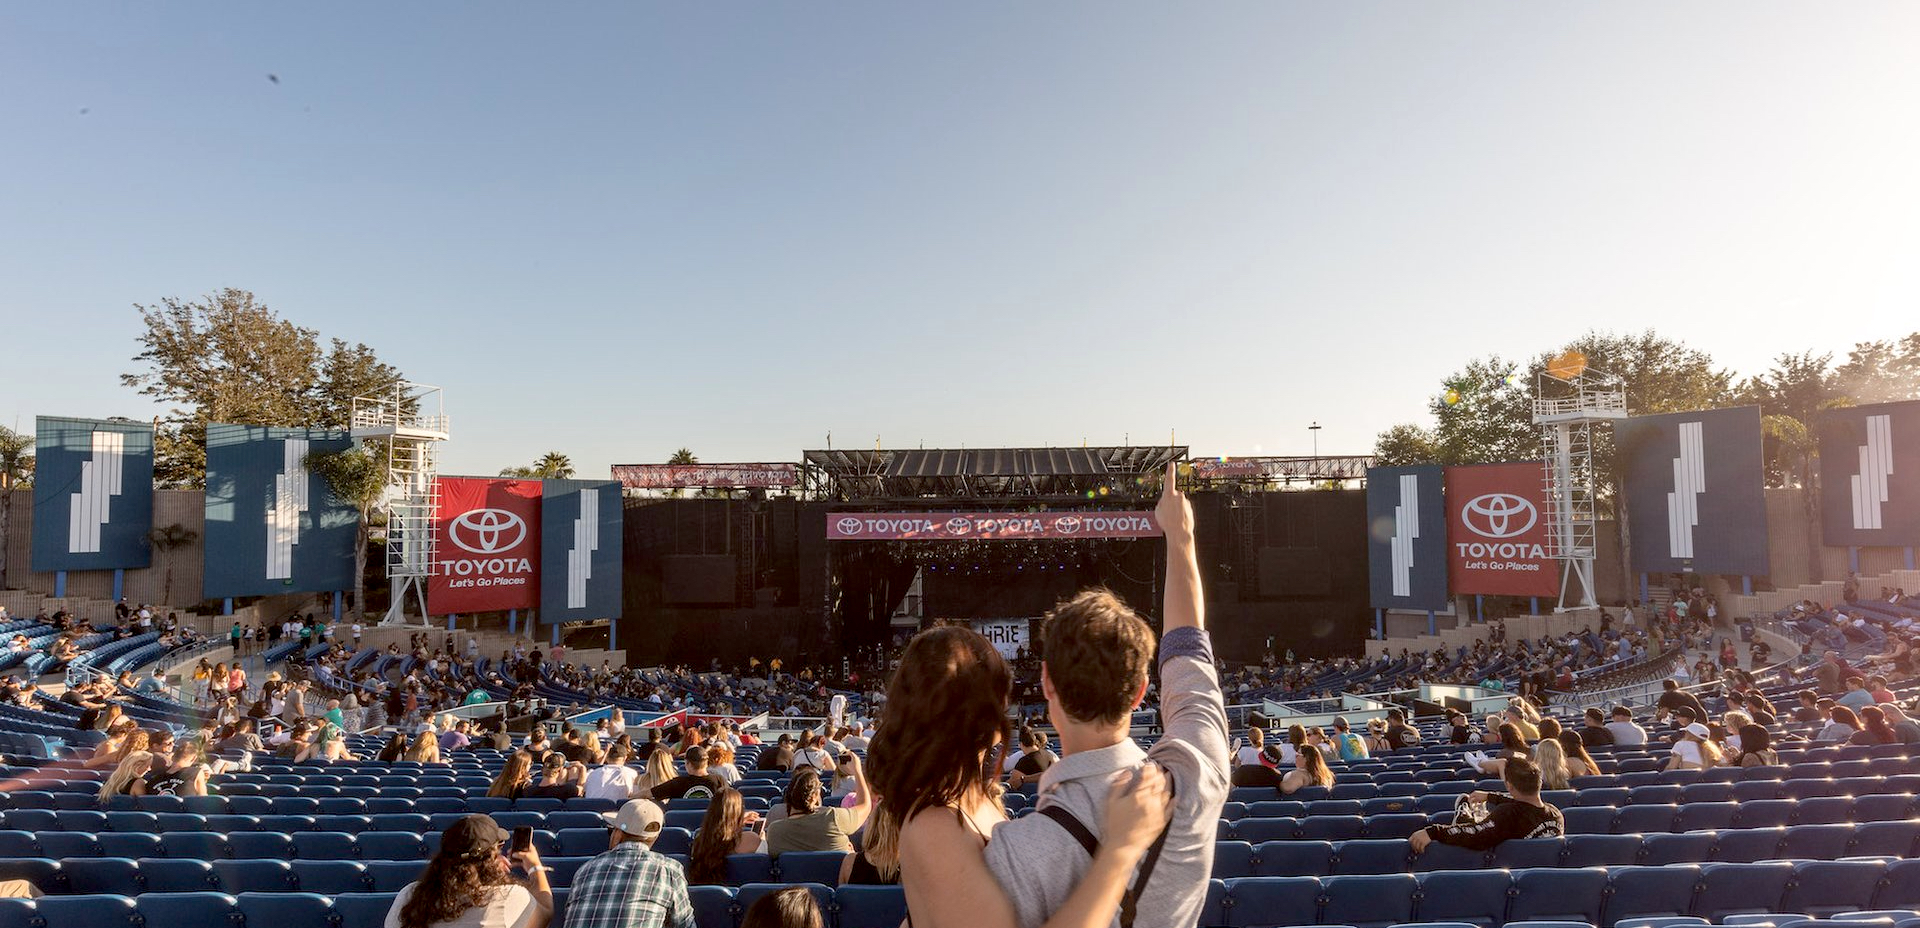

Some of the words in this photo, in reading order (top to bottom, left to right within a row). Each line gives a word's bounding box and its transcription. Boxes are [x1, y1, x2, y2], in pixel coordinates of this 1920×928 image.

[753, 470, 791, 479] TOYOTA
[865, 518, 935, 534] TOYOTA
[974, 518, 1044, 533] TOYOTA
[1084, 516, 1152, 531] TOYOTA
[1456, 542, 1545, 559] TOYOTA
[440, 558, 532, 576] TOYOTA
[1465, 560, 1488, 569] Let's
[1490, 561, 1504, 570] Go
[1505, 561, 1540, 571] Places
[449, 577, 475, 588] Let's
[477, 577, 491, 587] Go
[492, 576, 525, 586] Places
